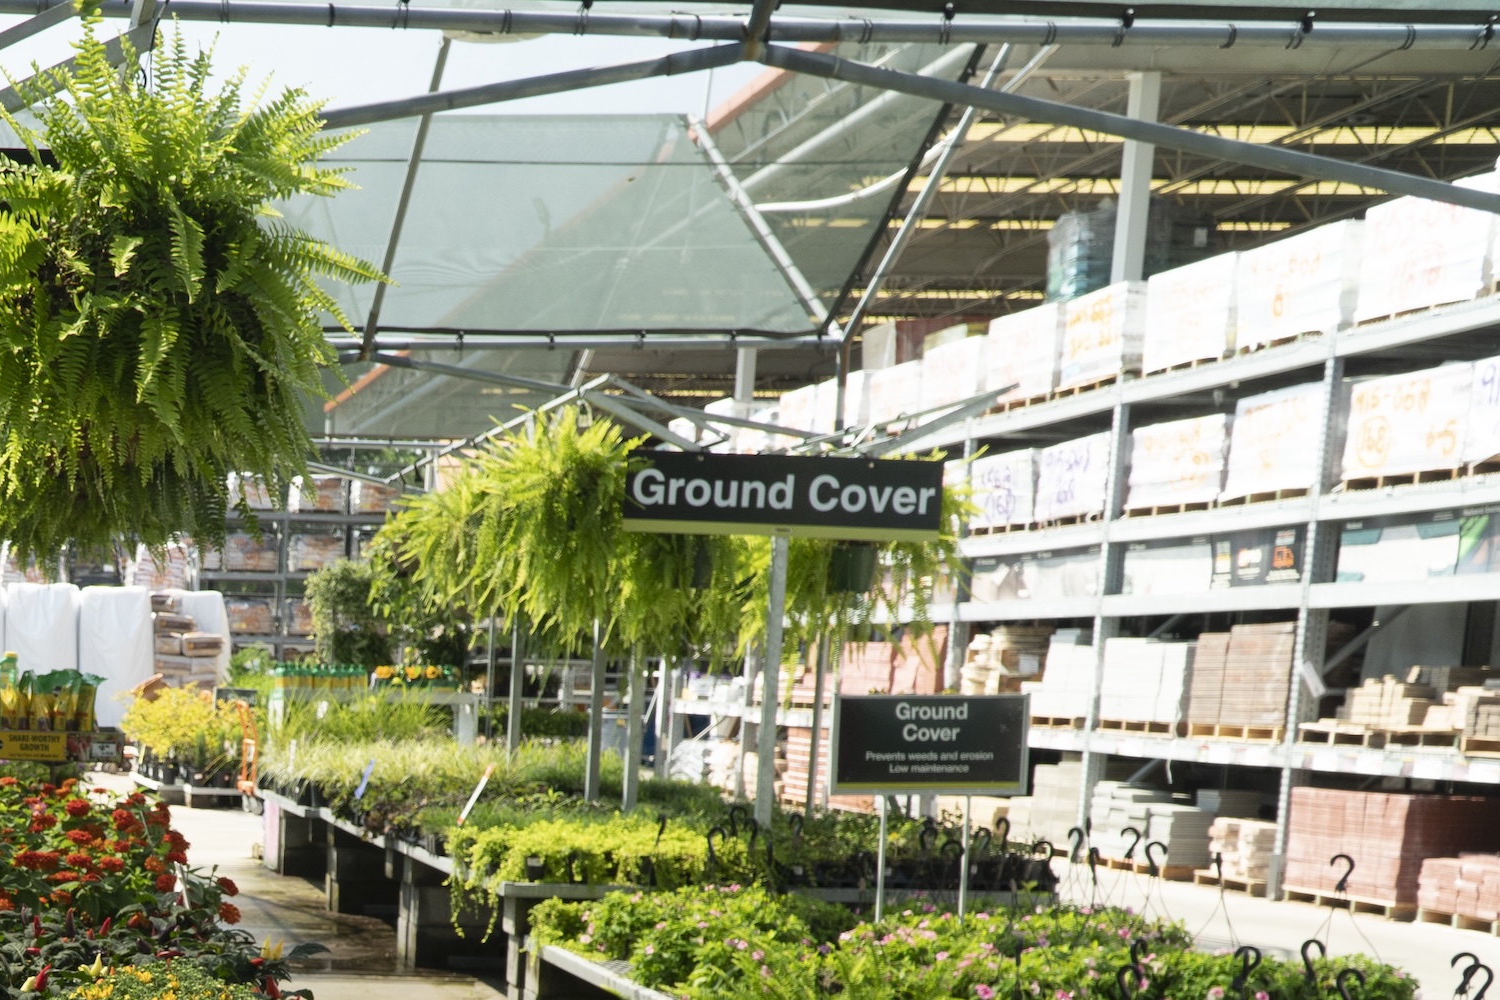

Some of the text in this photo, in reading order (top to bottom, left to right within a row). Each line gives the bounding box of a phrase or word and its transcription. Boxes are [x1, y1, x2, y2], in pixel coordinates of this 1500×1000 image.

[632, 467, 796, 511] Ground
[808, 473, 936, 515] Cover
[895, 701, 969, 720] Ground
[902, 723, 961, 742] Cover
[19, 743, 50, 752] GROWTH
[865, 750, 994, 762] Prevents weeds and erosion
[889, 763, 970, 774] Low maintenance
